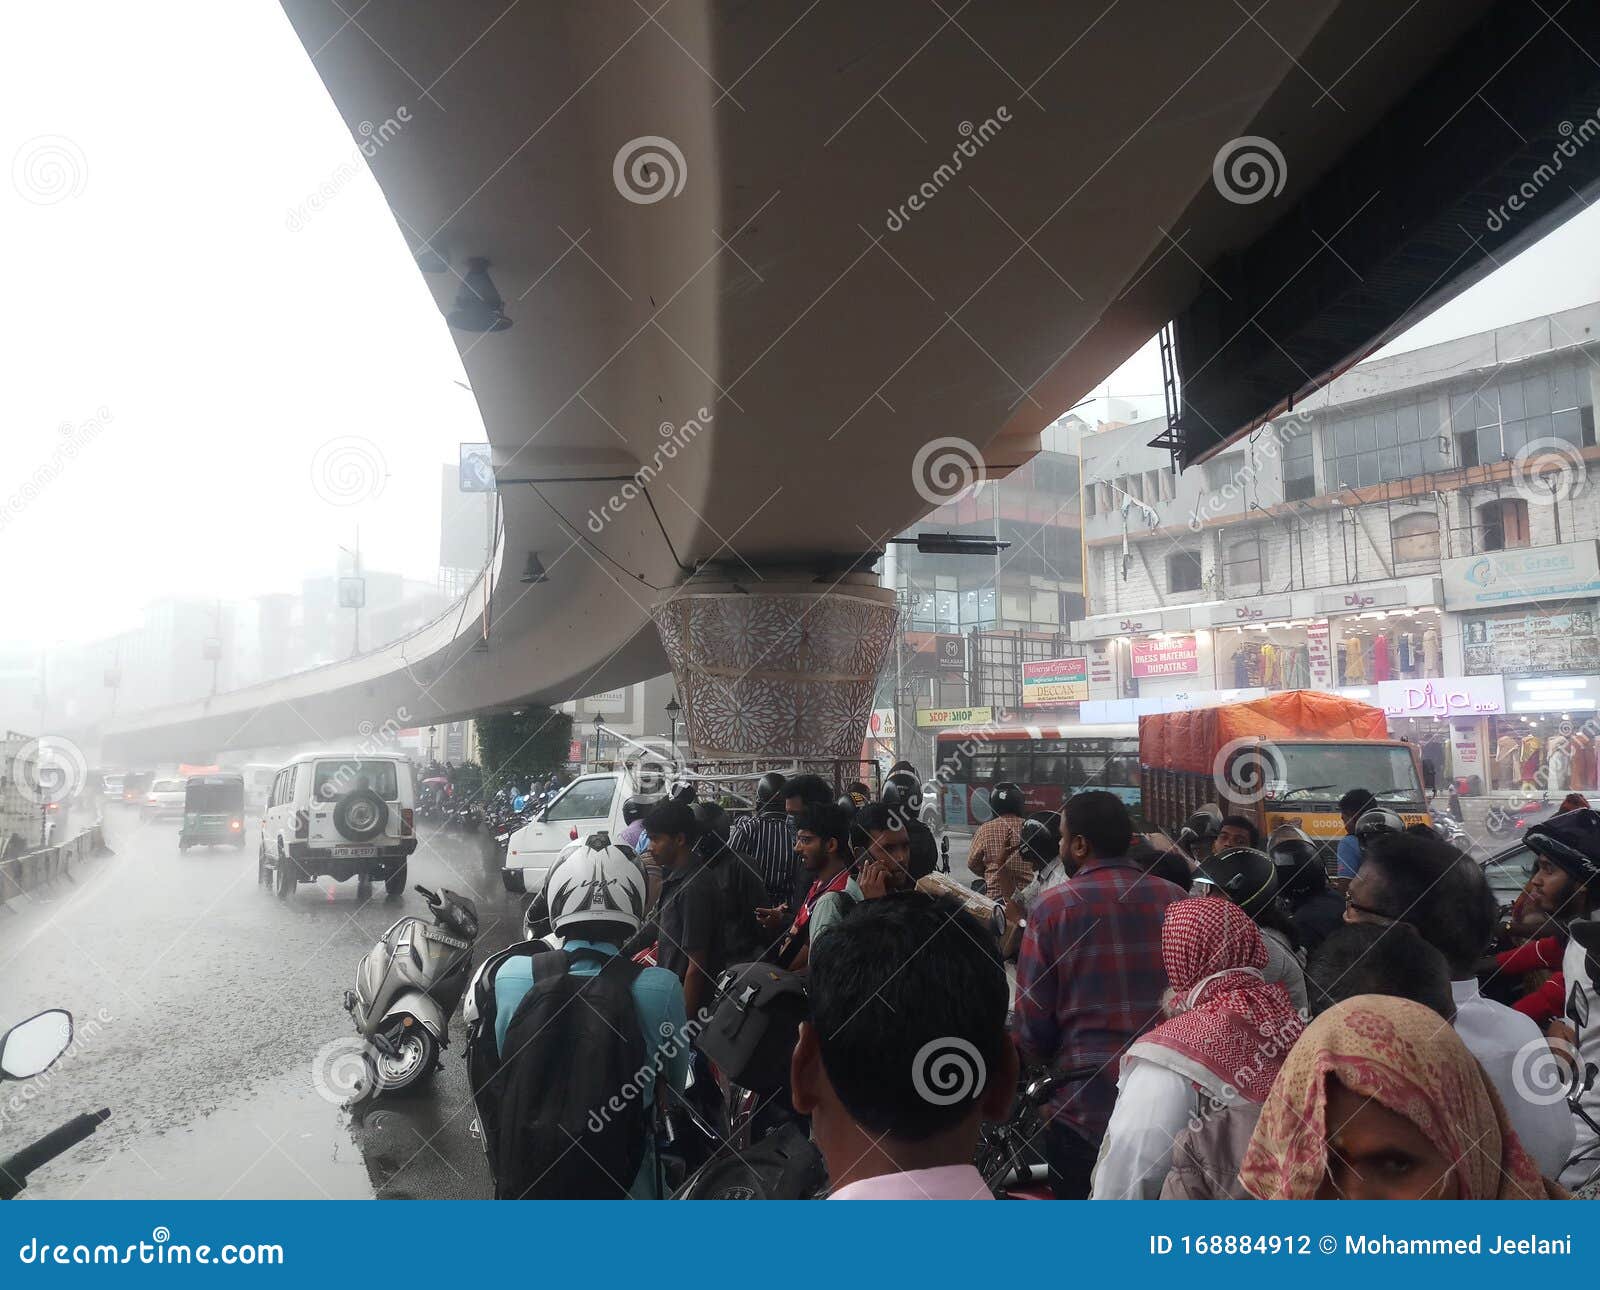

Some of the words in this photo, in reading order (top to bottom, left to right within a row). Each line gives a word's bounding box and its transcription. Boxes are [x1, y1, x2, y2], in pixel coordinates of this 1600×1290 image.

[1344, 592, 1375, 608] Diya
[1236, 605, 1263, 622] Diya
[1135, 654, 1158, 664] DRESS
[1147, 662, 1188, 674] DUPATTAS
[1037, 685, 1074, 697] DECCAN
[1407, 681, 1472, 718] Diya
[1312, 819, 1346, 829] GOODS
